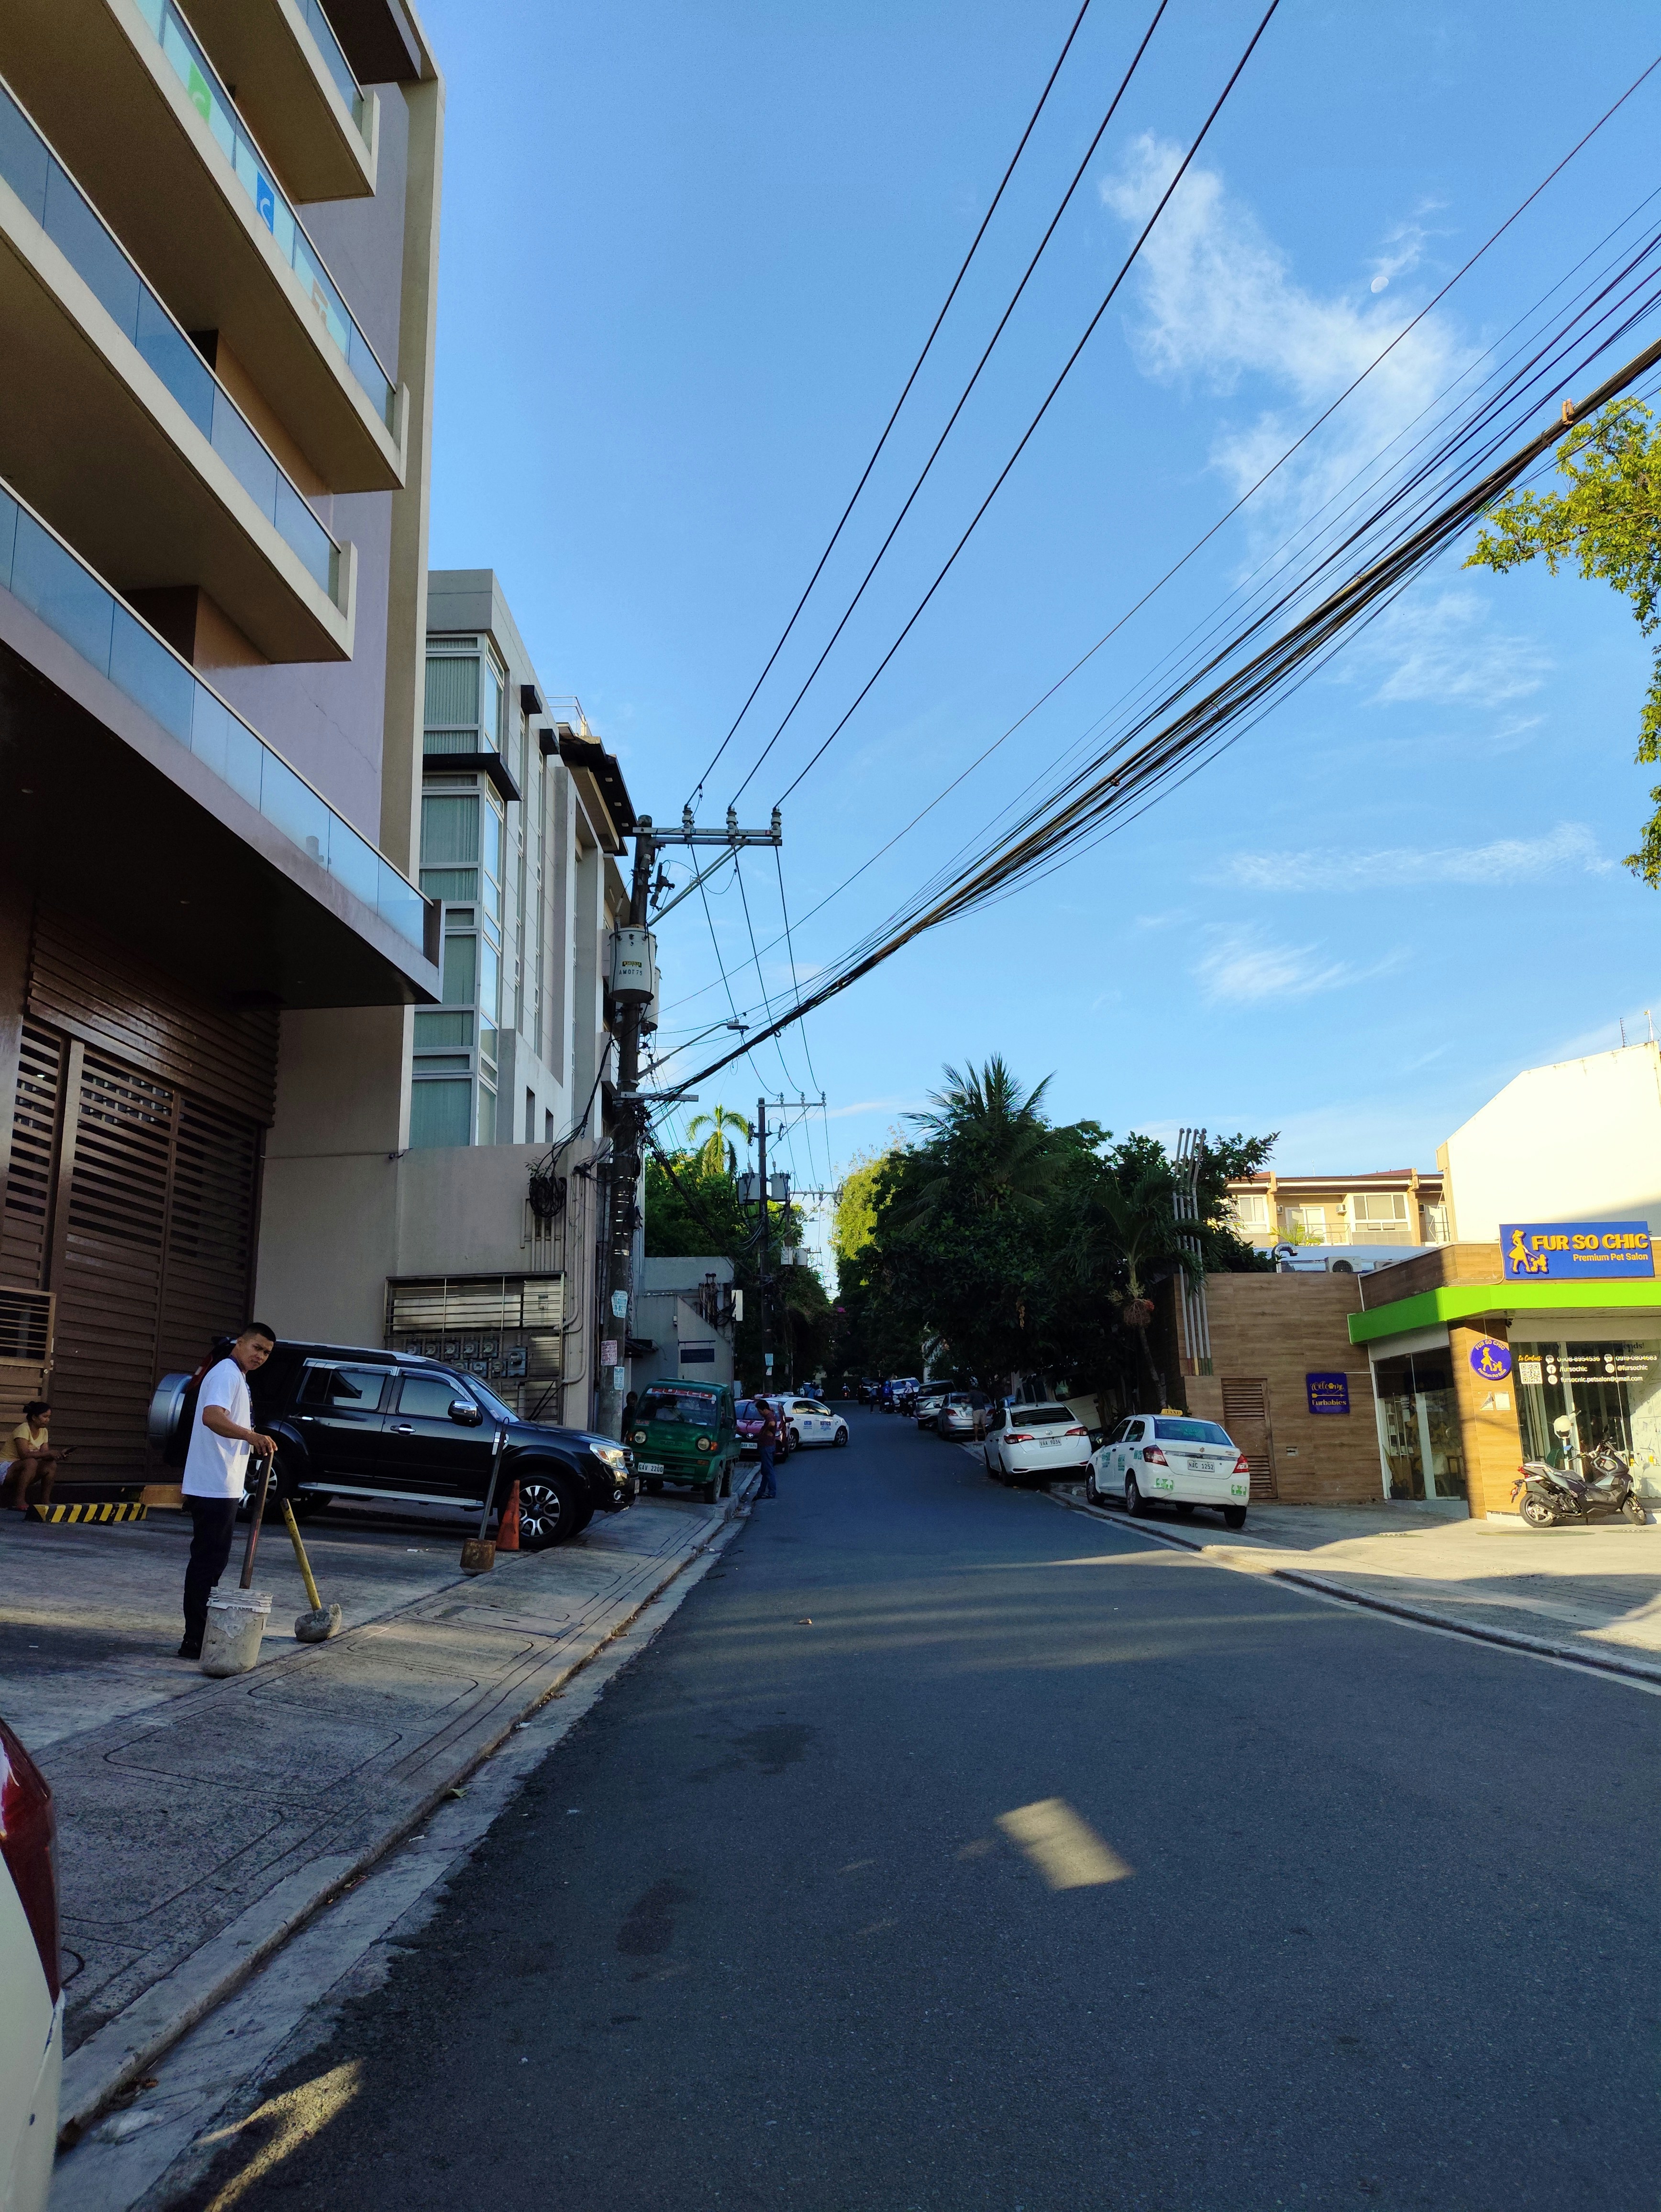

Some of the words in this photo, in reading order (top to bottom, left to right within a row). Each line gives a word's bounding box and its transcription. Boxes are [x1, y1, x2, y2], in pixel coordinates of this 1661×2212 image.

[1531, 1235, 1570, 1251] FUR
[1572, 1234, 1600, 1250] SO
[1602, 1233, 1649, 1250] CHIC
[1573, 1253, 1609, 1261] Premium
[1611, 1253, 1625, 1261] Pet
[1626, 1252, 1649, 1261] Salon
[1475, 1341, 1485, 1350] FUR
[1493, 1340, 1506, 1350] CHIC
